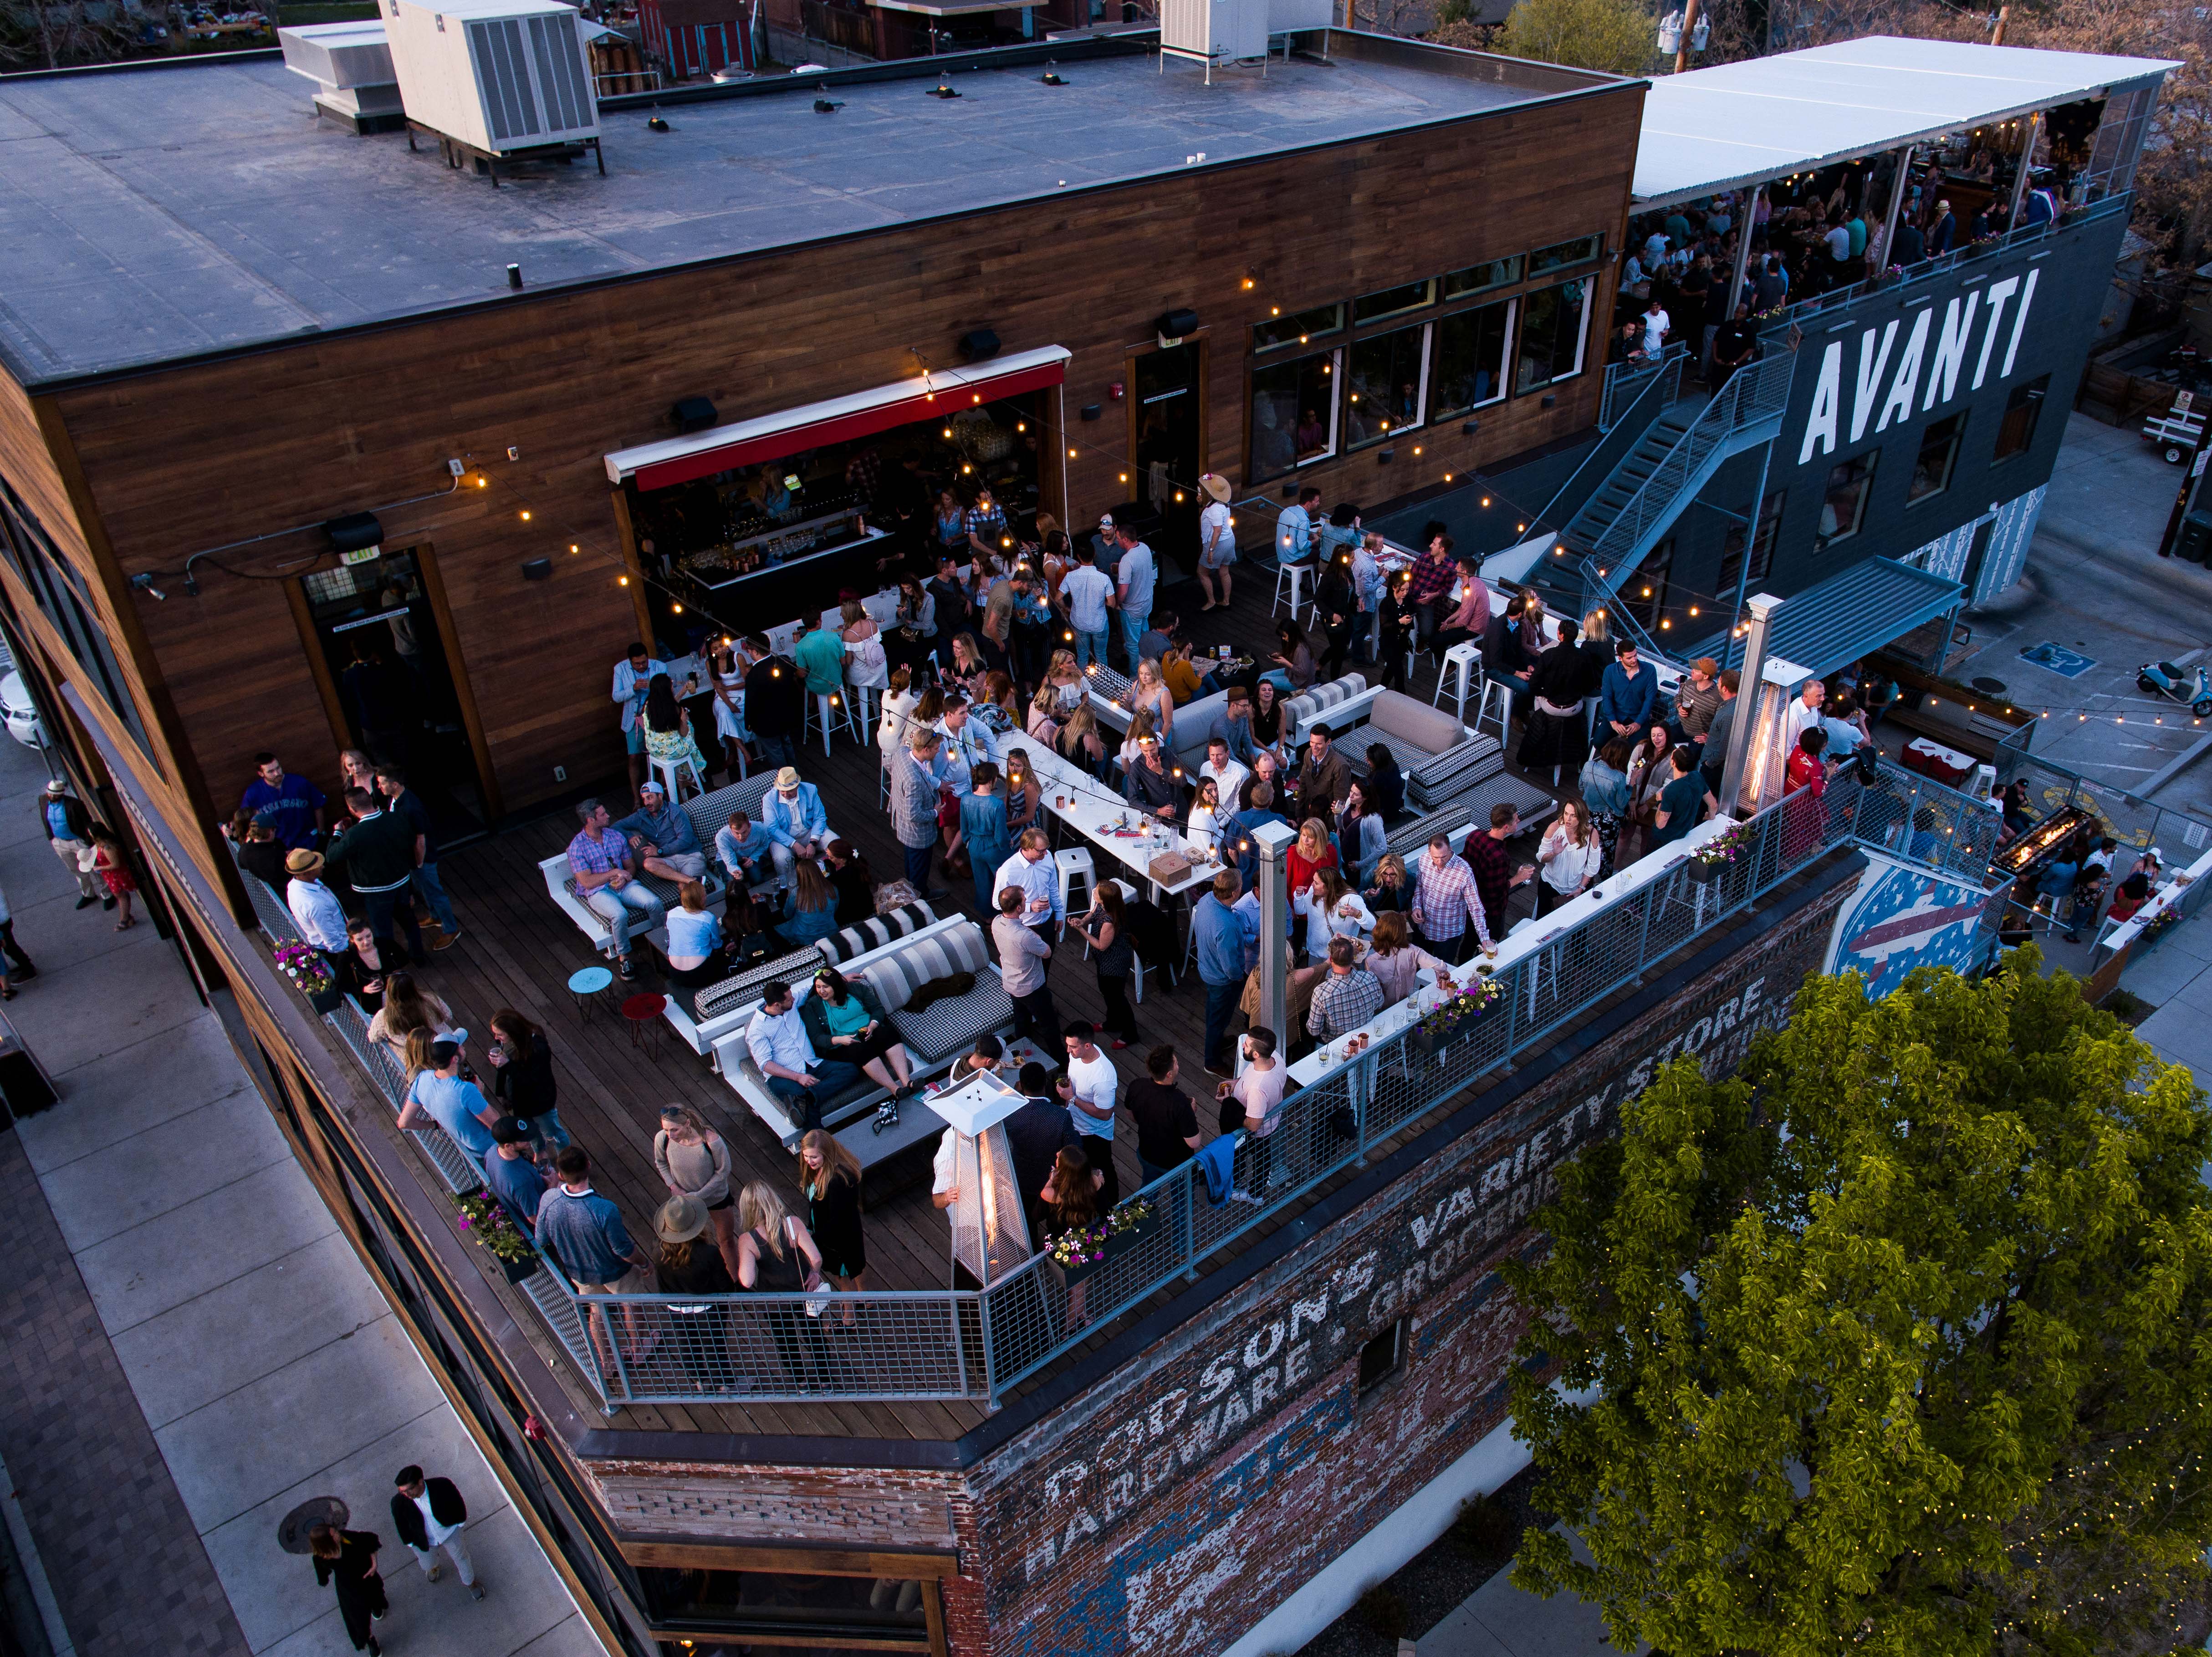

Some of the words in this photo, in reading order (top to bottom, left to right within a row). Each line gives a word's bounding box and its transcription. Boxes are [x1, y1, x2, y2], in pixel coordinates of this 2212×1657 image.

[1798, 269, 2039, 465] AVANTI
[1410, 1082, 1612, 1249] VARIETY
[1626, 975, 1765, 1087] STORE
[1024, 1338, 1312, 1581] HARDWARE
